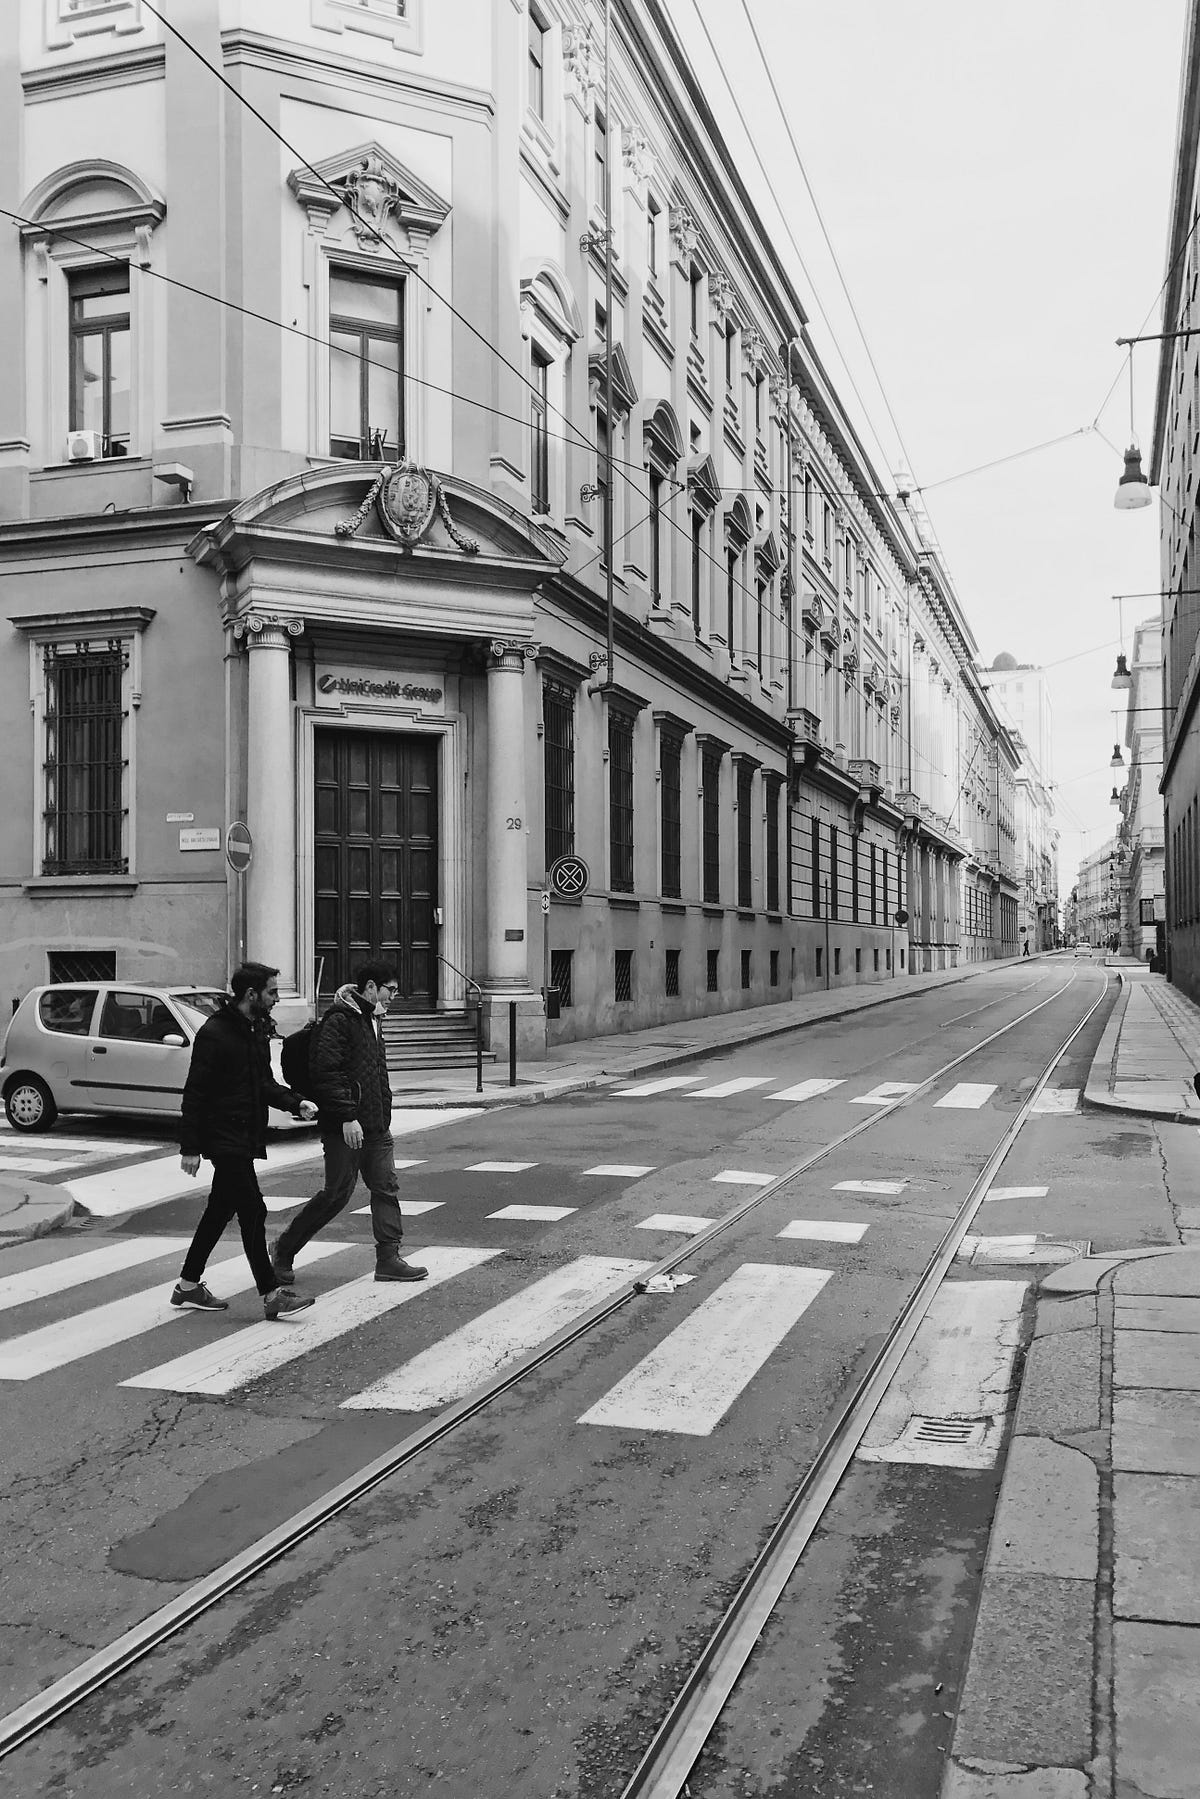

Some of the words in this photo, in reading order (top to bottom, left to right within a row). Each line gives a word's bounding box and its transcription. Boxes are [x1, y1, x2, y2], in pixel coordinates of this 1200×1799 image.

[339, 678, 401, 699] UniCredit
[402, 683, 442, 703] Group
[506, 817, 521, 830] 29
